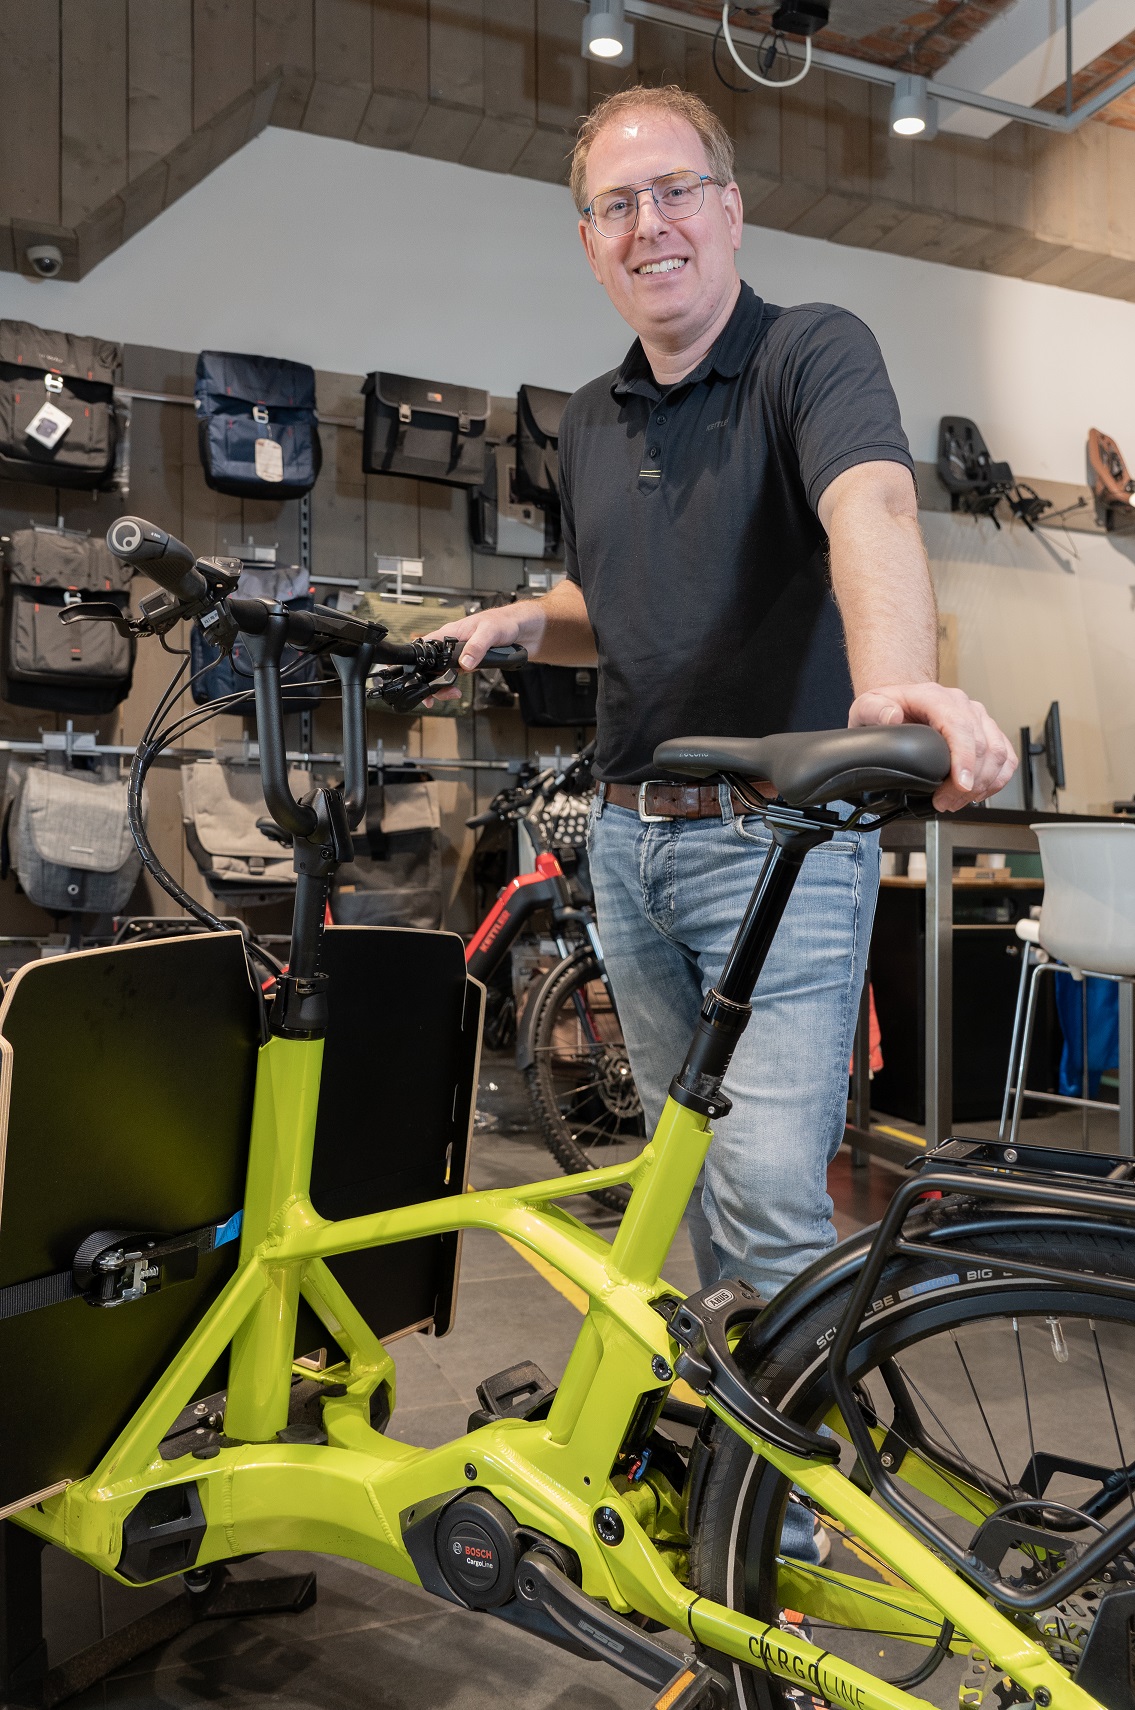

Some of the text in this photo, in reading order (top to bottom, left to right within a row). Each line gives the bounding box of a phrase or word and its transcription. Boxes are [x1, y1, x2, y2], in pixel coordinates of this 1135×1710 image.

[479, 909, 511, 953] KETTLER
[967, 1269, 993, 1282] BIG
[709, 1292, 730, 1307] ABUS
[465, 1545, 493, 1560] BOSCH
[466, 1557, 494, 1569] CargoLine
[748, 1635, 866, 1710] CARGOLINE
